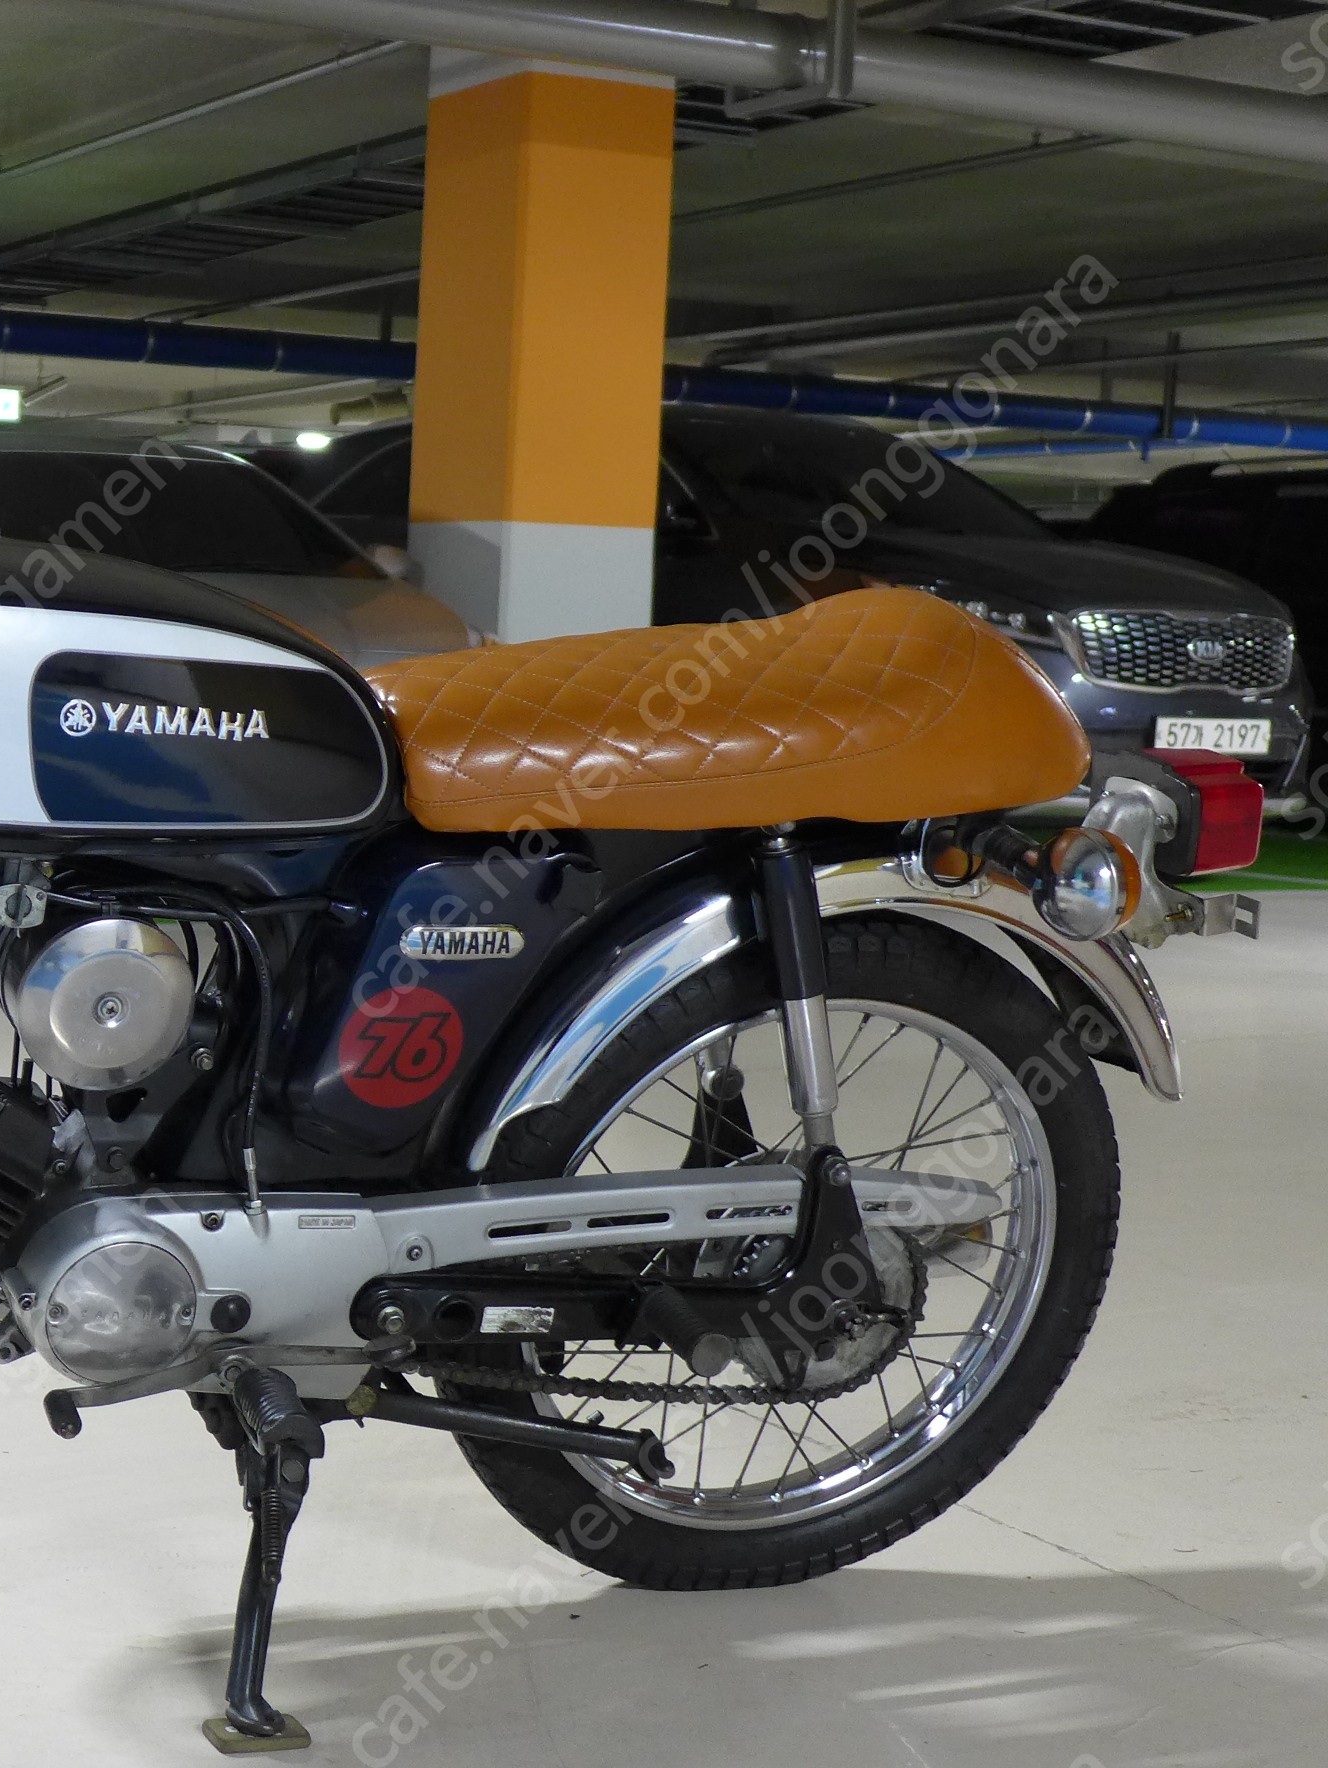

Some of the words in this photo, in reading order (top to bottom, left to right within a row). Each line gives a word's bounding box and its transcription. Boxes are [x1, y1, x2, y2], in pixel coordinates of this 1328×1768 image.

[102, 702, 270, 742] YAMAHA
[1212, 723, 1261, 748] 2197
[419, 931, 510, 955] YAMAHA
[353, 1012, 451, 1083] 76
